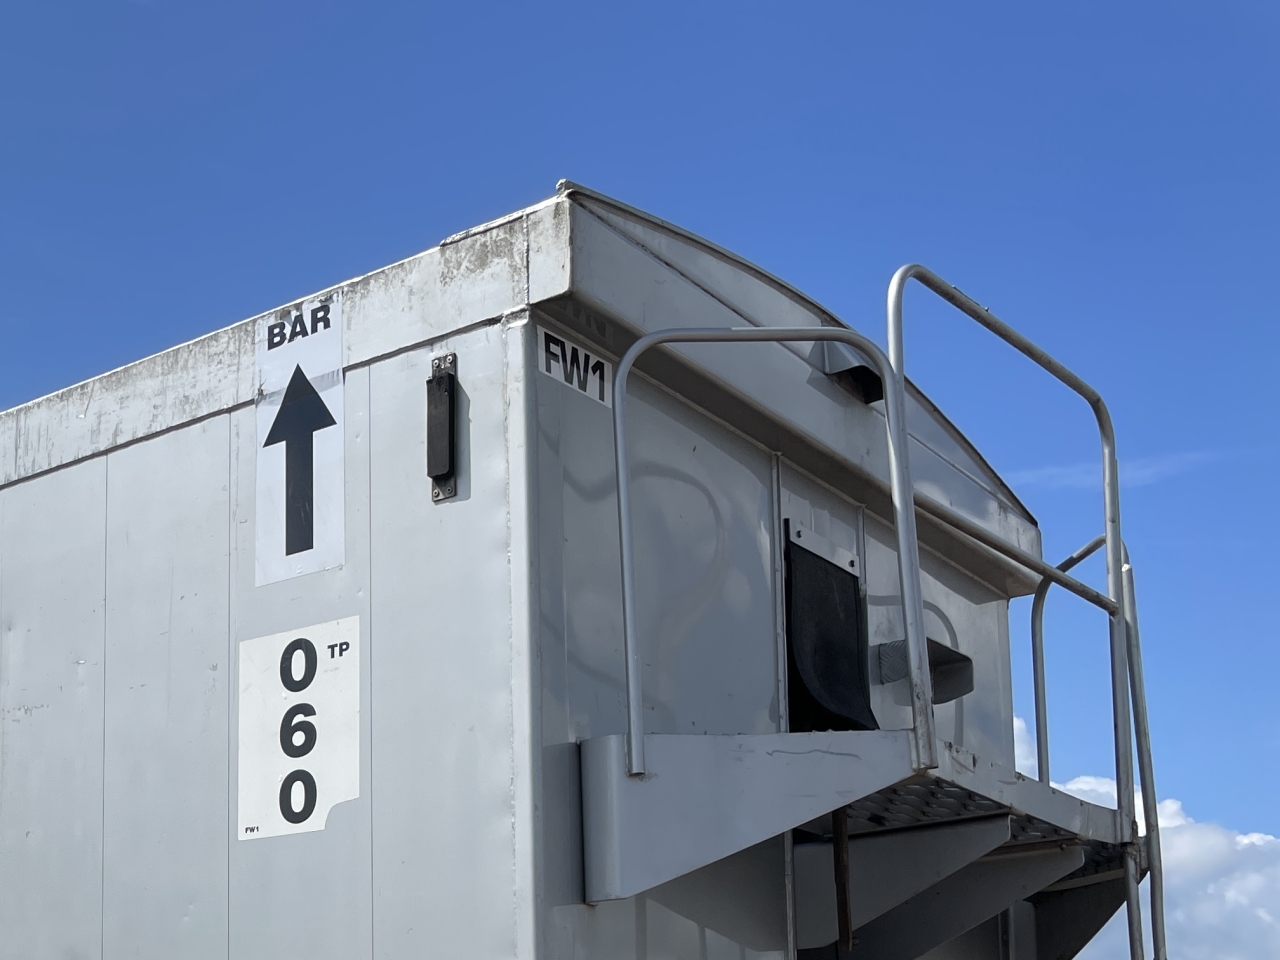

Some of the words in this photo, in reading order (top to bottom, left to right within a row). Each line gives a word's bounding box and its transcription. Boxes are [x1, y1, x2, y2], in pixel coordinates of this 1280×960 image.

[267, 304, 331, 351] BAR
[544, 331, 605, 402] FW1
[327, 641, 350, 659] TP
